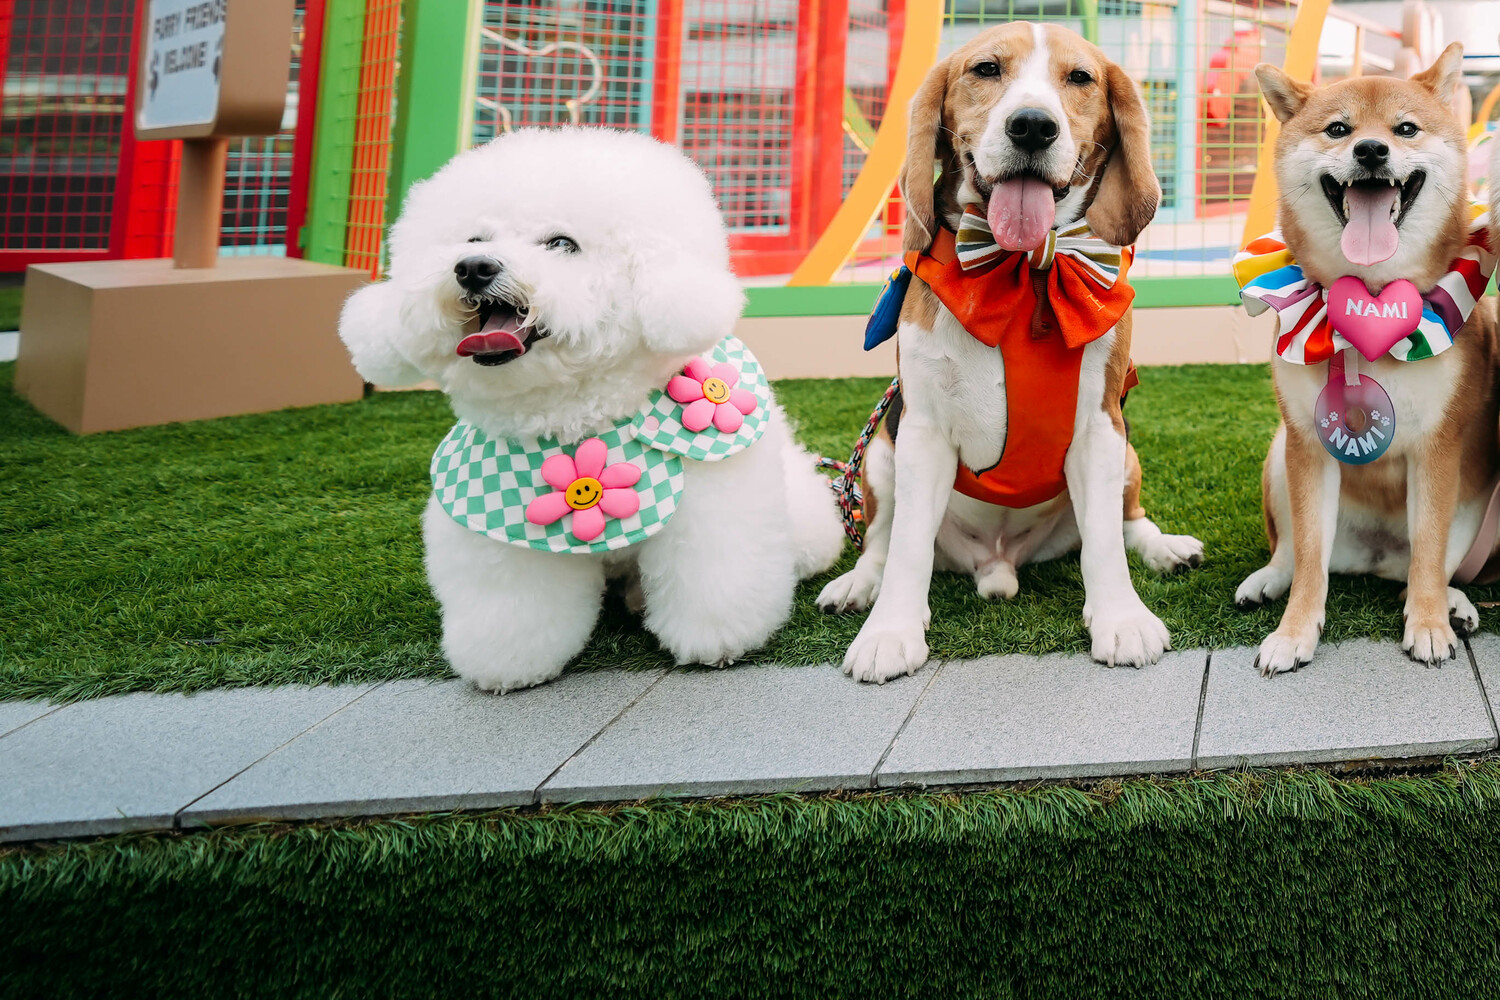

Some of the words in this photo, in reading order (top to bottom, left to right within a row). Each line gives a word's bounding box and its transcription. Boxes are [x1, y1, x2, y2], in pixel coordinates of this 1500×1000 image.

[154, 11, 181, 42] FURRY
[1345, 298, 1408, 319] NAMI
[1328, 425, 1386, 457] NAMI
